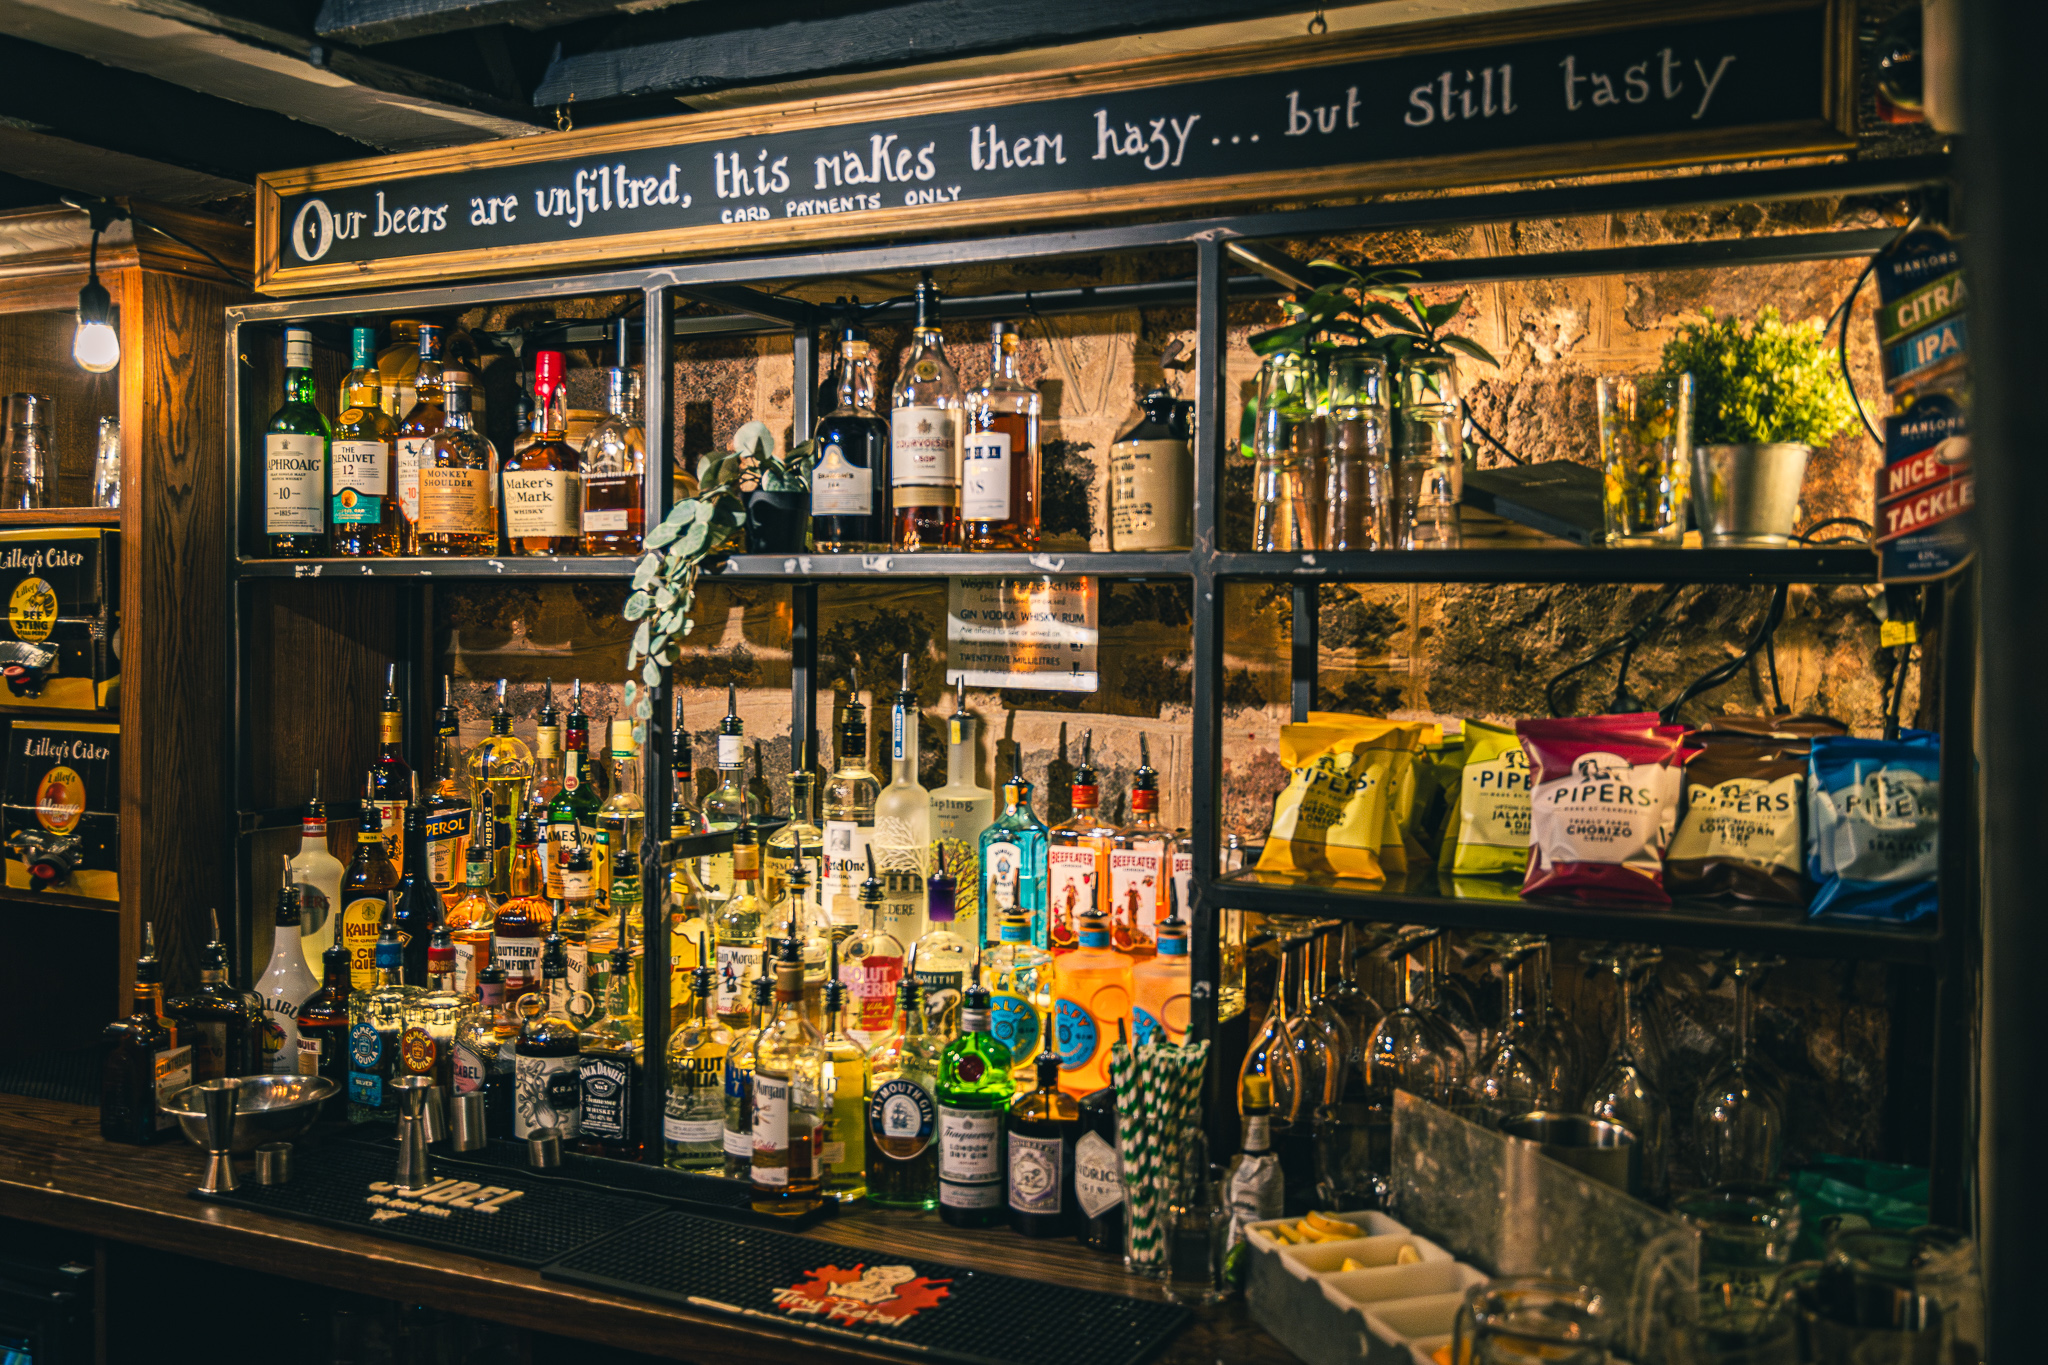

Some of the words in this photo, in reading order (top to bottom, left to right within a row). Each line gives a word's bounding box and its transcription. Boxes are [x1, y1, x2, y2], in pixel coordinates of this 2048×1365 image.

[292, 200, 362, 262] Our
[373, 191, 449, 238] beers
[470, 194, 519, 227] are
[536, 163, 692, 229] unfiltred,
[714, 148, 790, 199] this
[970, 123, 1067, 171] them
[1284, 86, 1362, 136] but
[1404, 62, 1519, 127] still
[1558, 47, 1737, 119] tasty
[721, 206, 771, 224] CARD
[786, 193, 881, 217] PAYMENTS
[904, 185, 961, 206] ONLY
[1897, 276, 1966, 329] CITRA
[1916, 327, 1958, 364] IPA
[341, 446, 355, 454] THE
[267, 458, 320, 472] APHROAIG
[343, 465, 354, 475] 12
[427, 470, 468, 478] MONKEY
[1888, 453, 1938, 494] NICE
[424, 479, 473, 487] SHOULDER
[506, 478, 553, 489] Maker's
[279, 487, 290, 500] 10
[408, 487, 417, 499] 10
[517, 491, 553, 502] Mark
[1886, 482, 1974, 532] TACKLE
[46, 548, 84, 568] Cider
[23, 610, 43, 620] BEE
[960, 609, 977, 619] GIN
[982, 610, 1015, 621] VODKA
[1020, 611, 1057, 622] WHISKY
[1062, 613, 1085, 623] RUM
[16, 620, 48, 631] STING
[959, 653, 1010, 664] TWENTY-FIVE
[1012, 655, 1060, 666] MILLILITRES
[24, 738, 70, 764] Lilley's
[72, 740, 110, 760] Cider
[1480, 771, 1531, 791] PIPE
[1554, 783, 1650, 806] PIPERS
[1692, 790, 1789, 813] PIPERS
[1492, 811, 1531, 820] JALAP
[426, 817, 466, 837] PEROL
[1566, 824, 1632, 837] CHORIZO
[547, 830, 596, 846] AMESON
[1051, 851, 1093, 865] BEEFEATER
[1113, 855, 1157, 870] BEEFEATER
[346, 923, 380, 937] KAHL
[497, 946, 539, 957] OUTHERN
[351, 959, 376, 969] IQUE
[266, 998, 298, 1020] LIBU
[992, 1000, 1032, 1020] ALFY
[1056, 1003, 1089, 1027] ALFY
[353, 1026, 377, 1042] OLMECA
[406, 1030, 432, 1047] OLMECA
[353, 1048, 379, 1065] TEQUILA
[406, 1052, 432, 1069] TEQUILA
[454, 1065, 481, 1079] CABEL
[580, 1065, 597, 1080] JACK
[597, 1061, 626, 1085] DANIEL'S
[355, 1079, 373, 1087] SILVER
[552, 1085, 577, 1094] KRA
[872, 1082, 921, 1118] PLYMOUTH
[919, 1099, 932, 1122] GIN
[586, 1106, 616, 1115] WHISKEY
[949, 1144, 988, 1152] LONDON
[827, 1302, 912, 1328] Rebel
